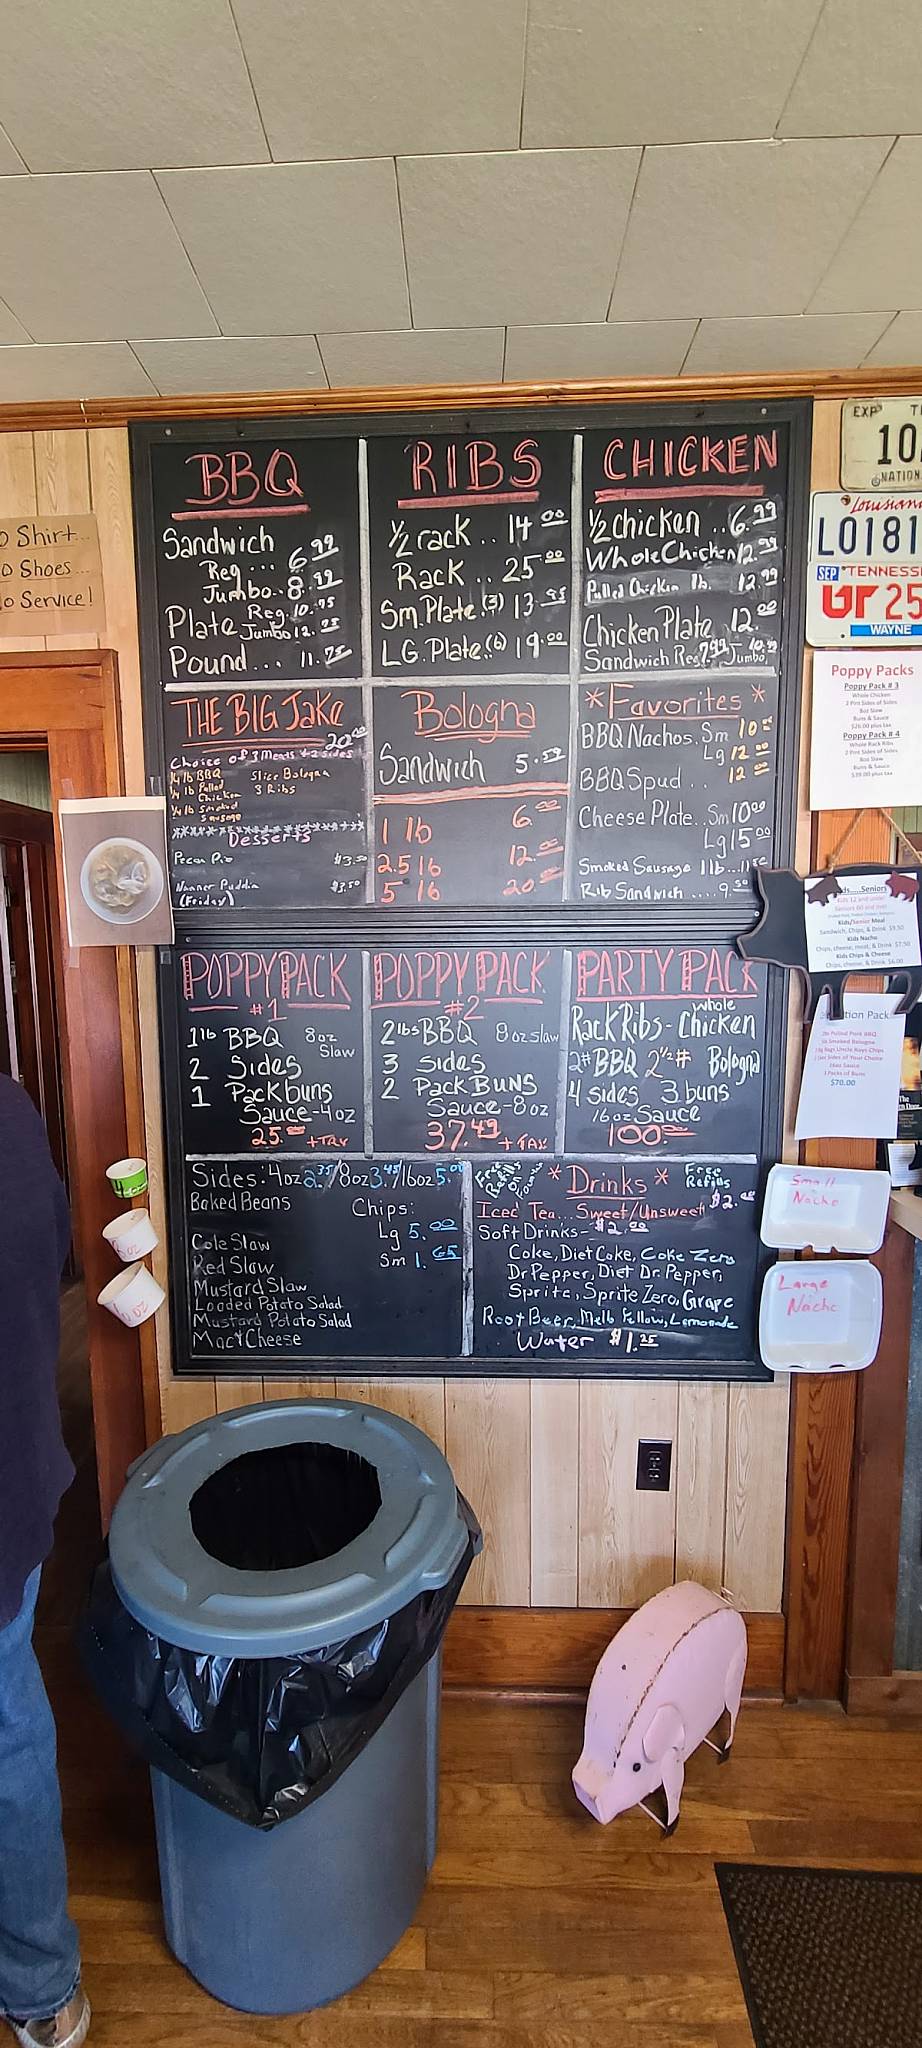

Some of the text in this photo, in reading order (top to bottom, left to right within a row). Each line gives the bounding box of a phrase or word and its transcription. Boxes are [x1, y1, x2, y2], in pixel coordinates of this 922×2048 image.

[878, 424, 922, 464] 10
[604, 430, 778, 480] CHICKEN
[185, 449, 305, 505] BBQ
[412, 439, 542, 495] RIBS
[163, 525, 274, 559] Sandwich
[586, 540, 736, 571] Whole Chicken
[392, 559, 465, 590] Rack
[818, 567, 837, 580] SEP
[849, 566, 922, 576] TENNESS
[21, 586, 92, 608] Service!
[587, 579, 624, 600] Pulled
[165, 605, 237, 639] Plate
[239, 623, 291, 641] Jumbo
[583, 605, 712, 648] Chicken Plate
[870, 625, 912, 635] WAYNE
[584, 649, 670, 671] Sandwich
[832, 664, 914, 679] Poppy Packs
[171, 694, 279, 737] THE BIG
[401, 690, 536, 743] Bologna
[580, 723, 623, 749] BBQ
[843, 732, 866, 740] Poppy
[170, 756, 221, 769] Choice
[229, 750, 247, 764] of
[379, 743, 486, 786] Sandwich
[703, 745, 724, 765] Lg
[197, 770, 221, 780] BBQ
[251, 772, 278, 781] Slice
[579, 767, 624, 792] BBQ
[267, 784, 295, 794] Ribs
[579, 806, 646, 828] Cheese
[228, 832, 312, 848] Desserts
[579, 856, 691, 878] Smoked Sausage
[179, 890, 235, 907] (Friday)
[380, 881, 403, 902] 5
[581, 883, 611, 898] Rib
[577, 949, 674, 996] PARTY
[692, 998, 735, 1012] whole
[867, 1010, 889, 1019] Pack
[418, 1017, 478, 1045] BBQ
[572, 1002, 619, 1045] Rack
[223, 1027, 284, 1050] BBQ
[320, 1045, 355, 1058] Slaw
[189, 1053, 302, 1080] 2 Sides
[382, 1054, 399, 1074] 3
[593, 1045, 760, 1085] BBQ Bologna
[381, 1078, 399, 1099] 2
[413, 1077, 468, 1096] Pack
[569, 1080, 729, 1106] 4 sides 3 buns
[831, 1079, 855, 1087] $70.00
[191, 1086, 211, 1107] 1
[224, 1081, 283, 1103] Pack
[634, 1106, 700, 1124] Sauce
[685, 1163, 722, 1176] Free
[566, 1165, 647, 1195] Drinks
[791, 1175, 836, 1187] Small
[191, 1192, 291, 1211] Baked Beans
[352, 1198, 415, 1221] Chips:
[476, 1201, 519, 1218] Iced
[793, 1192, 839, 1207] Nacho
[192, 1233, 270, 1251] Cole Slaw
[378, 1221, 400, 1251] Lg
[479, 1225, 519, 1241] Soft
[641, 1247, 685, 1261] Coke
[193, 1255, 275, 1275] Red Slaw
[597, 1264, 633, 1278] Diet
[193, 1277, 307, 1297] Mustard Slaw
[778, 1276, 829, 1291] Large
[195, 1296, 343, 1312] Loaded Potato Salad
[682, 1289, 733, 1313] Grape
[193, 1312, 352, 1329] Mustard Potato Salad
[483, 1306, 525, 1326] Root
[517, 1331, 594, 1352] Water
